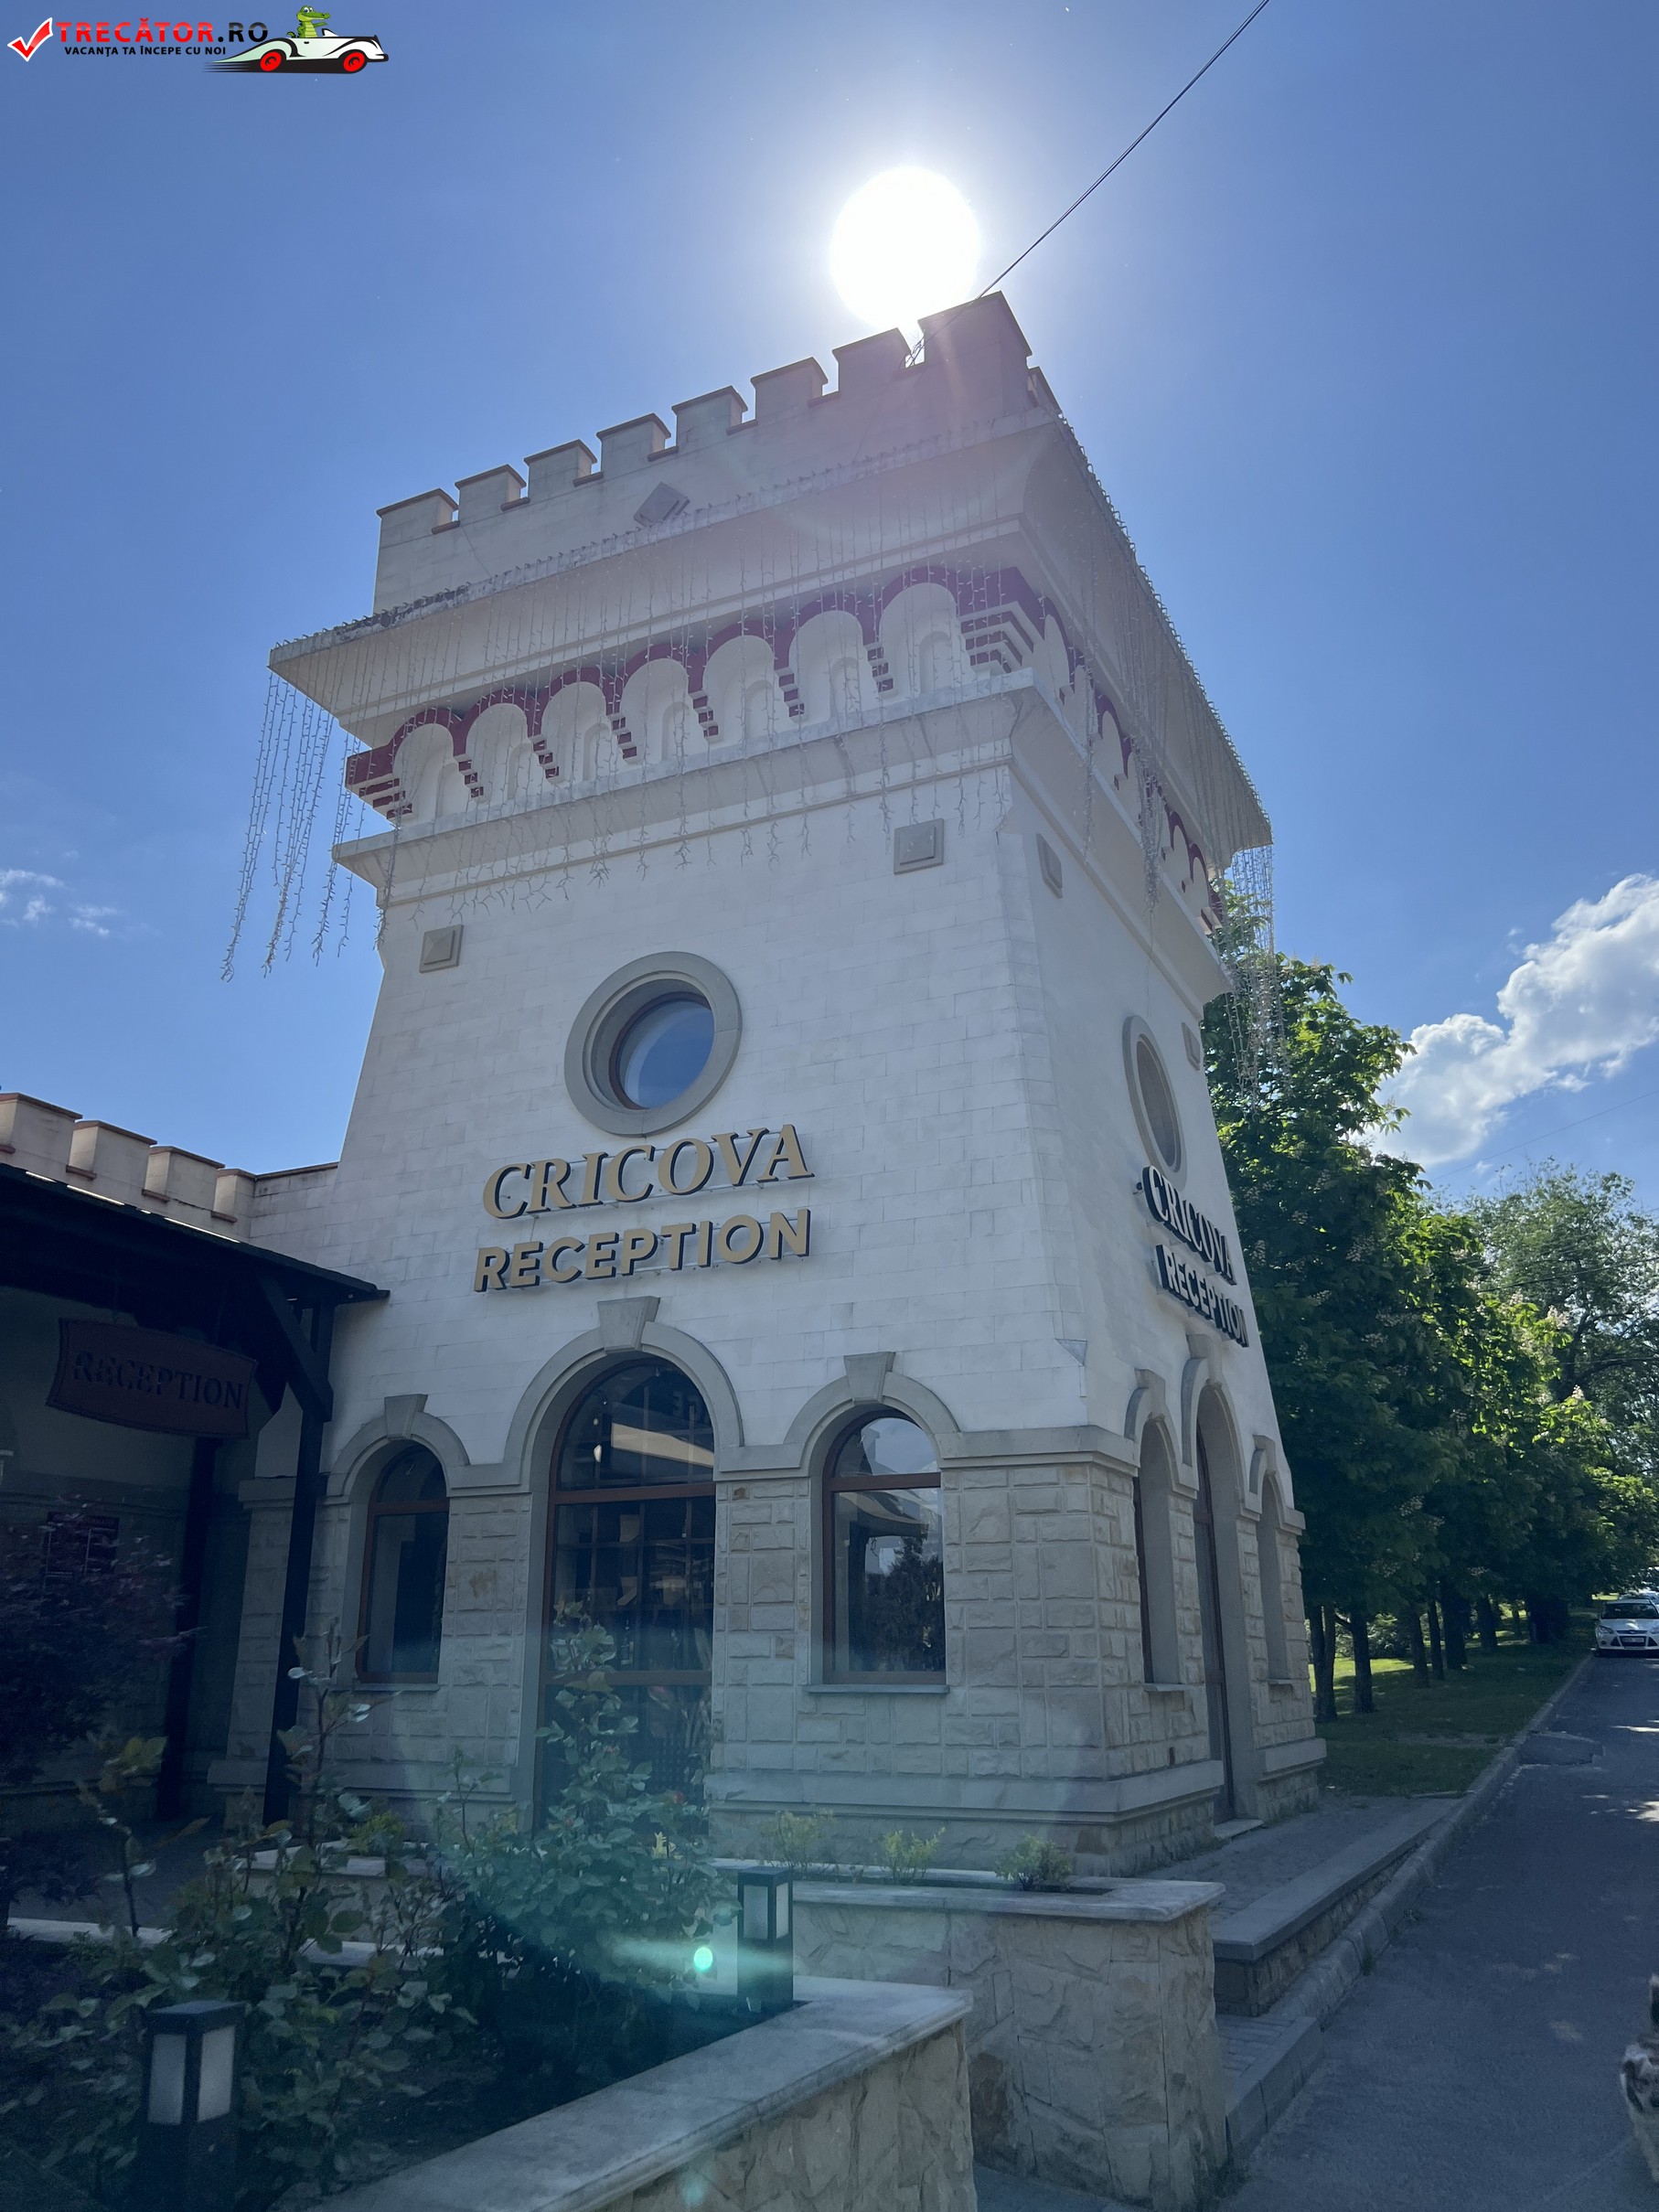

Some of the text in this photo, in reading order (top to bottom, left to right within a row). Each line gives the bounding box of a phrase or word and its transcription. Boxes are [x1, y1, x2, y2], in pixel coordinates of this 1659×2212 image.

[483, 1124, 815, 1220] CRICOVA
[474, 1208, 811, 1293] RECEPTION
[1142, 1165, 1237, 1286] CRICOVA
[1156, 1245, 1250, 1348] RECEPTION
[72, 1350, 243, 1410] RECEPTION
